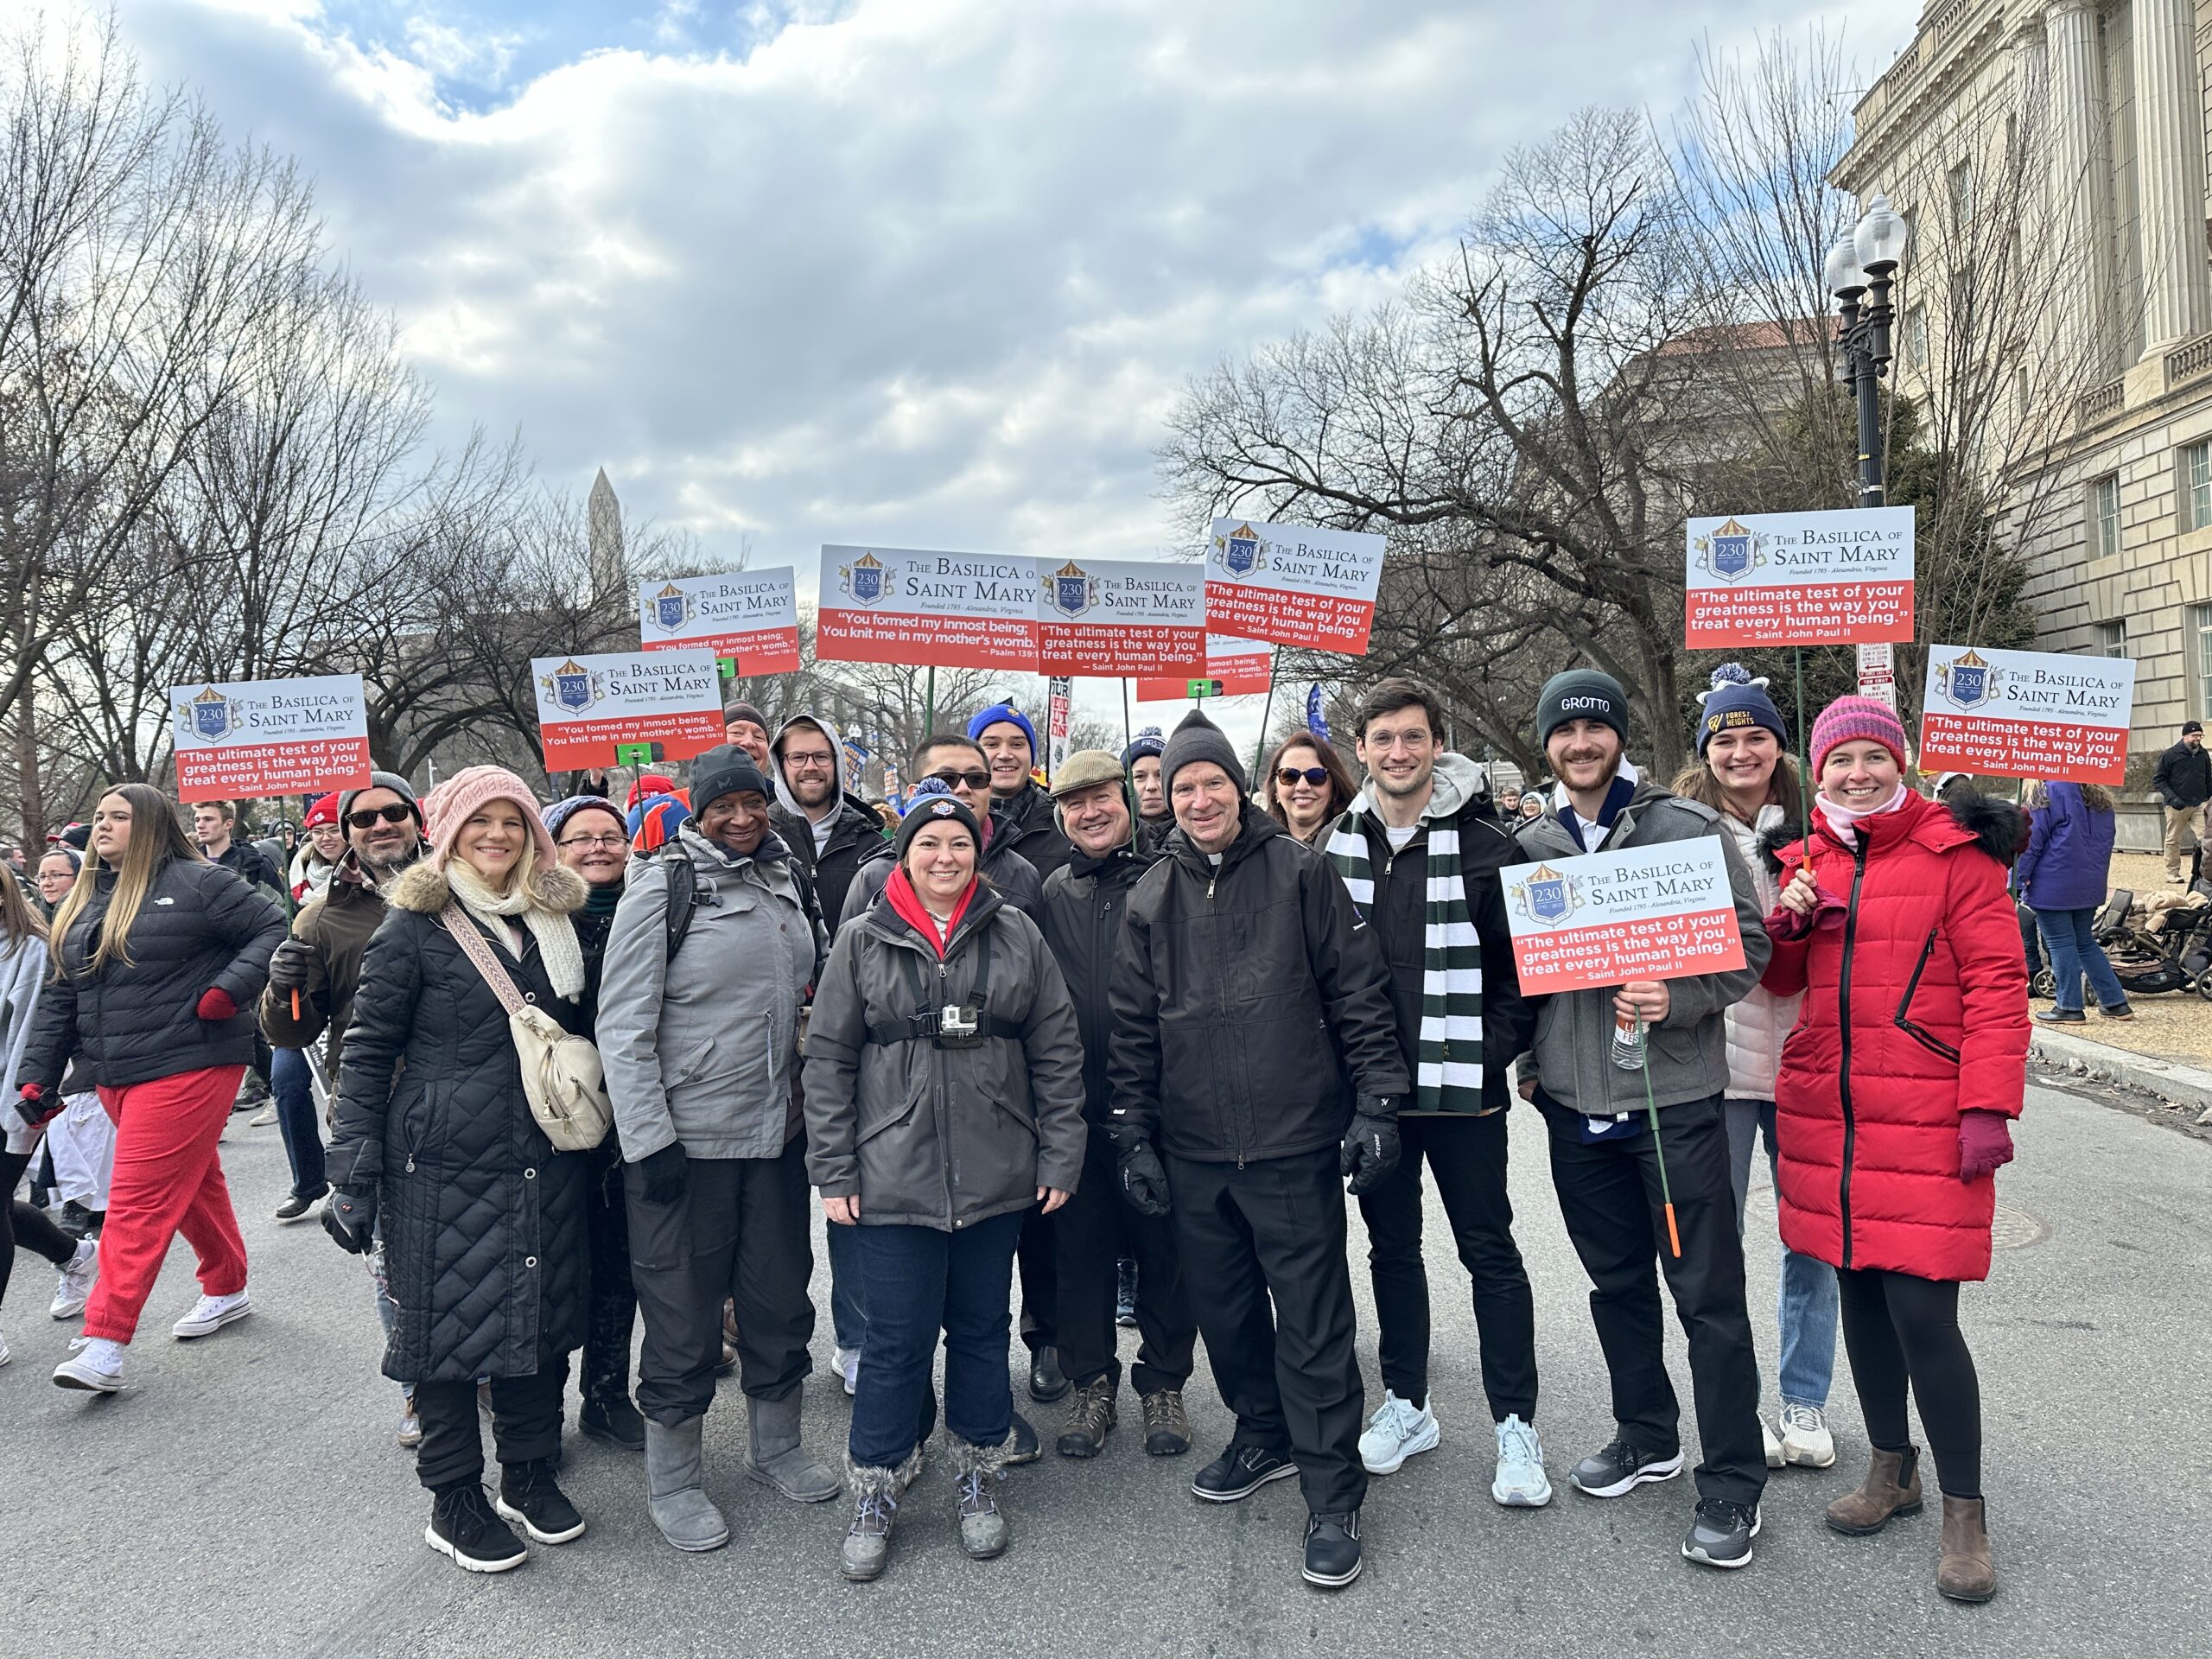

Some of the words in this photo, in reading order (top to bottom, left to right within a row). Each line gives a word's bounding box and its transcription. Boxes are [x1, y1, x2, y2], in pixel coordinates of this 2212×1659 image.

[1774, 535, 1797, 545] THE
[1801, 530, 1882, 545] BASILICA
[1888, 532, 1903, 540] OF
[1275, 544, 1293, 555] THE
[1295, 543, 1357, 563] BASILICA
[1718, 543, 1745, 557] 230
[1775, 549, 1832, 566] SAINT
[1839, 545, 1900, 562] MARY
[906, 560, 931, 573] THE
[936, 557, 1020, 579] BASILICA
[1272, 557, 1317, 575] SAINT
[1321, 562, 1369, 582] MARY
[857, 573, 878, 585] 230
[1104, 580, 1121, 589] THE
[1125, 577, 1183, 592] BASILICA
[699, 590, 716, 599] THE
[719, 582, 775, 597] BASILICA
[906, 577, 967, 598] SAINT
[974, 581, 1036, 602] MARY
[1690, 591, 1729, 603] “The
[1734, 589, 1801, 602] ultimate
[1806, 586, 1838, 599] test
[1843, 585, 1861, 597] of
[1866, 586, 1904, 599] your
[701, 601, 742, 615] SAINT
[746, 595, 788, 610] MARY
[964, 605, 998, 613] Alexandria,
[1000, 606, 1024, 615] Virginia
[1105, 592, 1148, 608] SAINT
[1152, 594, 1195, 609] MARY
[1695, 604, 1774, 619] greatness
[1779, 601, 1792, 613] is
[1796, 600, 1824, 613] the
[1829, 601, 1862, 613] way
[1867, 600, 1899, 615] you
[838, 612, 870, 625] “You
[872, 613, 919, 627] formed
[921, 619, 941, 631] my
[944, 618, 987, 631] inmost
[989, 620, 1028, 636] being;
[1691, 618, 1730, 630] treat
[1735, 618, 1780, 629] every
[1785, 614, 1841, 626] human
[1846, 609, 1908, 625] being.”
[822, 625, 847, 637] You
[850, 626, 873, 639] knit
[876, 630, 896, 640] me
[898, 629, 910, 641] in
[912, 632, 933, 644] my
[935, 632, 990, 646] mother’s
[992, 636, 1038, 648] womb.
[1755, 630, 1783, 639] Saint
[1786, 629, 1813, 638] John
[1816, 628, 1840, 637] Paul
[1843, 628, 1850, 636] II
[990, 648, 1016, 656] Psalm
[2009, 671, 2030, 682] THE
[2033, 669, 2105, 689] BASILICA
[1562, 696, 1610, 712] GROTTO
[2007, 684, 2060, 703] SAINT
[2065, 689, 2120, 708] MARY
[558, 726, 584, 734] “You
[586, 721, 623, 732] formed
[643, 718, 676, 727] inmost
[678, 716, 709, 725] being;
[1726, 711, 1750, 719] FOREST
[1727, 717, 1754, 726] HEIGHTS
[546, 737, 567, 746] You
[569, 735, 589, 744] knit
[639, 727, 682, 738] mother’s
[179, 751, 213, 762] “The
[217, 747, 276, 760] ultimate
[279, 744, 307, 756] test
[310, 742, 325, 753] of
[329, 742, 360, 754] your
[182, 774, 216, 786] treat
[220, 772, 260, 783] every
[264, 769, 311, 780] human
[315, 761, 365, 776] being.”
[184, 761, 254, 777] greatness
[257, 758, 269, 769] is
[272, 757, 295, 768] the
[299, 756, 327, 766] way
[331, 754, 357, 766] you
[1587, 875, 1611, 886] THE
[1614, 862, 1694, 883] BASILICA
[1699, 861, 1713, 870] OF
[1592, 887, 1648, 905] SAINT
[1653, 877, 1714, 897] MARY
[1516, 936, 1554, 949] “The
[1559, 927, 1626, 945] ultimate
[1630, 921, 1663, 935] test
[1667, 917, 1684, 931] of
[1689, 914, 1727, 930] your
[1523, 944, 1602, 965] greatness
[1605, 940, 1619, 952] is
[1623, 937, 1650, 950] the
[1655, 933, 1688, 946] way
[1693, 928, 1725, 945] you
[1521, 961, 1561, 976] treat
[1565, 956, 1610, 971] every
[1614, 949, 1671, 965] human
[1674, 938, 1736, 957] being.”
